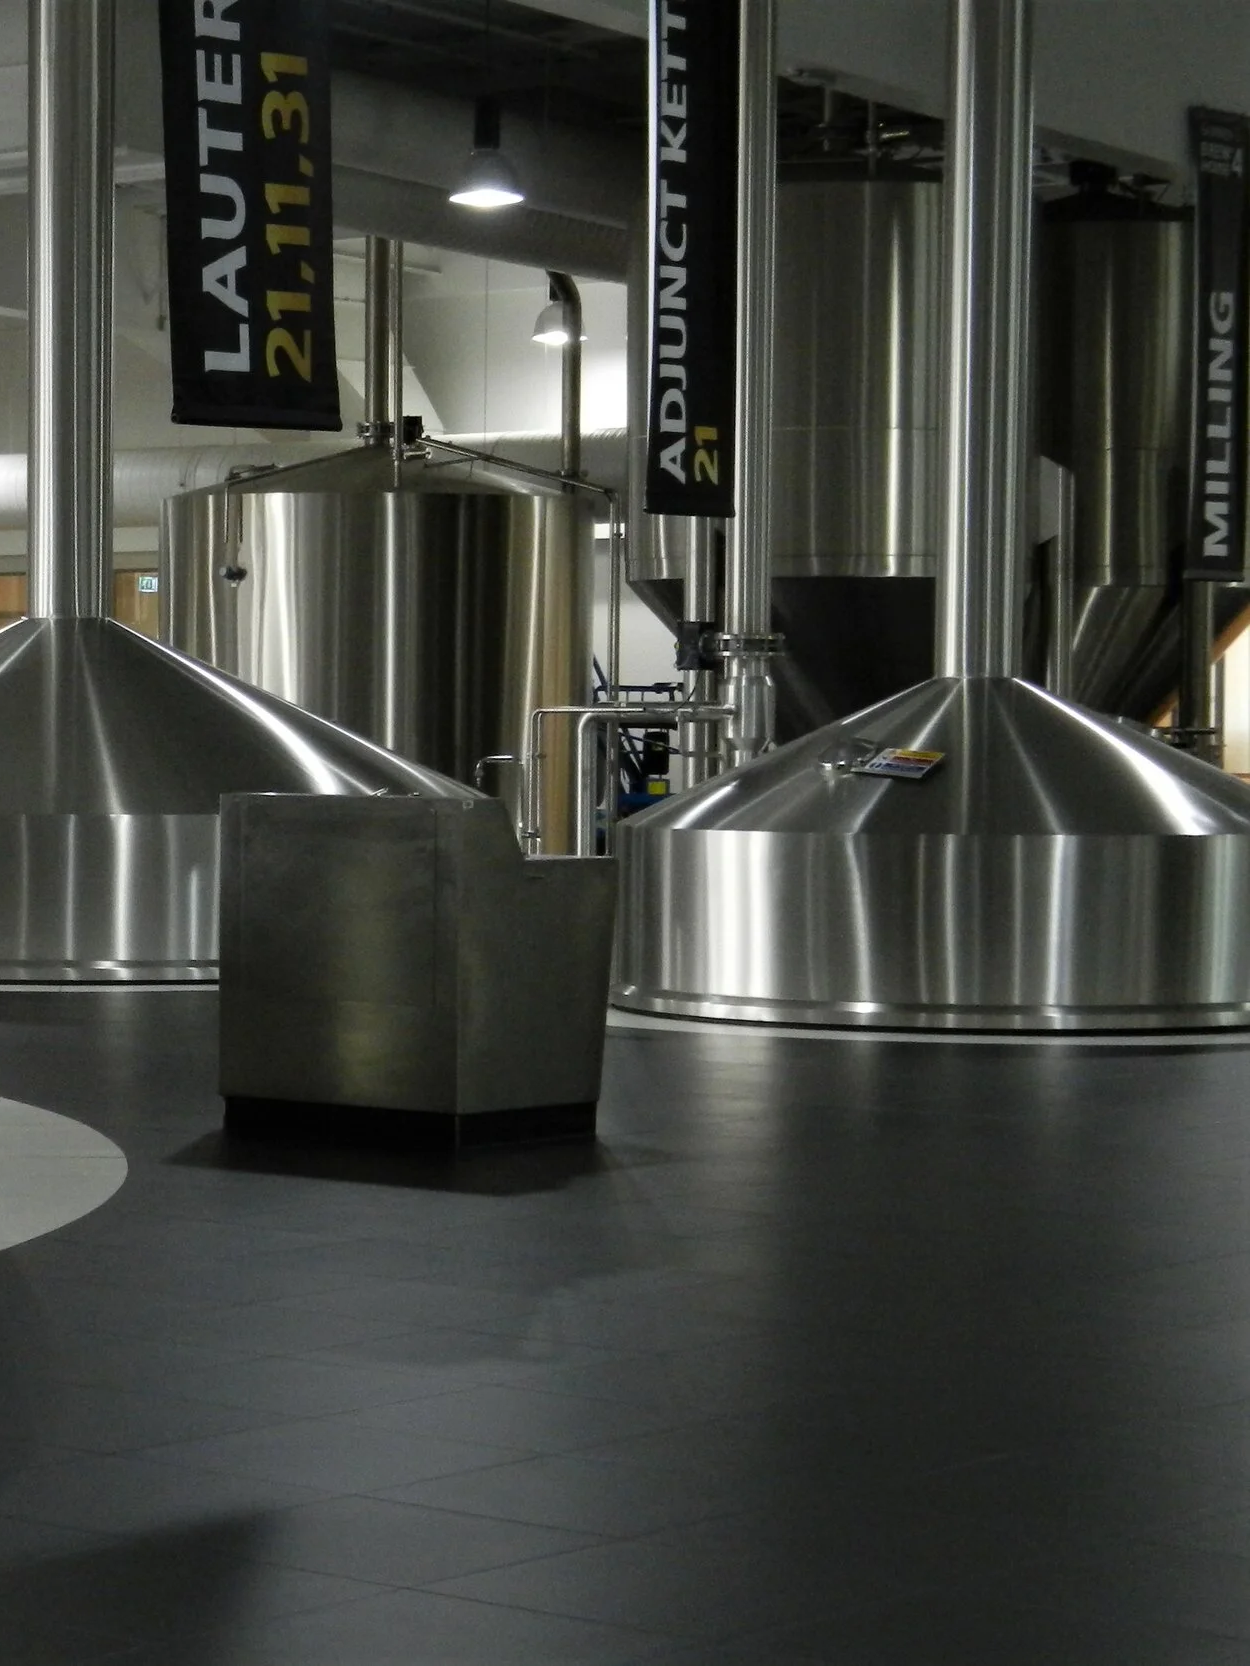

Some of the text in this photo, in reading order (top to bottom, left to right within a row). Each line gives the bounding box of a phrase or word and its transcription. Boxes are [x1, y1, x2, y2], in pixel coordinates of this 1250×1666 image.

[194, 0, 250, 372] LAUTER
[659, 179, 687, 484] ADJUNCT
[694, 427, 718, 484] 21
[1204, 293, 1232, 556] MILLING
